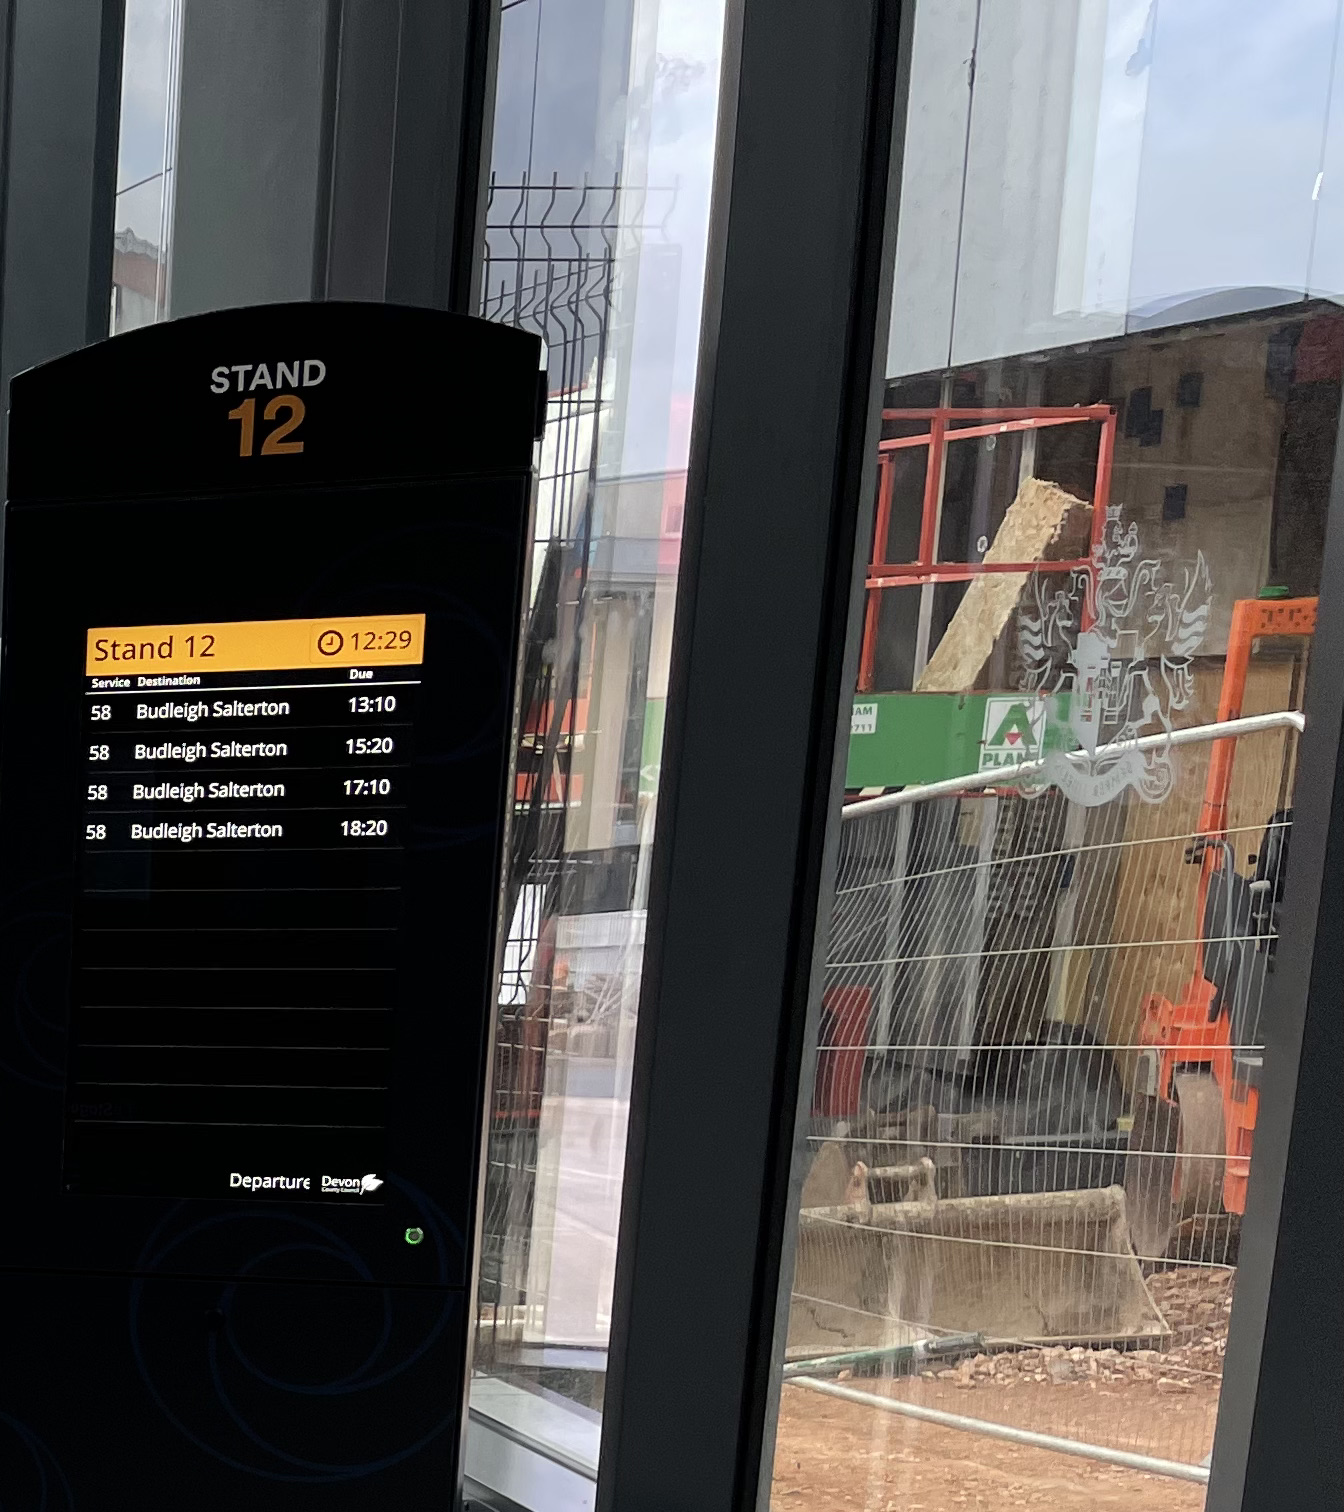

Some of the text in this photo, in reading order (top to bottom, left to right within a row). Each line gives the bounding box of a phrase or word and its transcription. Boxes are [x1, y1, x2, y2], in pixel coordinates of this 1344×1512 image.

[210, 359, 327, 394] STAND
[228, 395, 306, 457] 12
[94, 630, 412, 662] Stand 12 12:29
[91, 669, 373, 688] Service Destination Due
[90, 696, 396, 722] 58 Budleigh Salterton 13:10
[853, 706, 873, 716] AM
[851, 723, 873, 732] 711
[88, 737, 393, 762] 58 Budleigh Salterton 15:20
[87, 779, 390, 802] 58 Budleigh Salterton 17:10
[86, 820, 388, 842] 58 Budleigh Salterton 18:20
[229, 1172, 311, 1192] Departure
[321, 1175, 360, 1187] Devon
